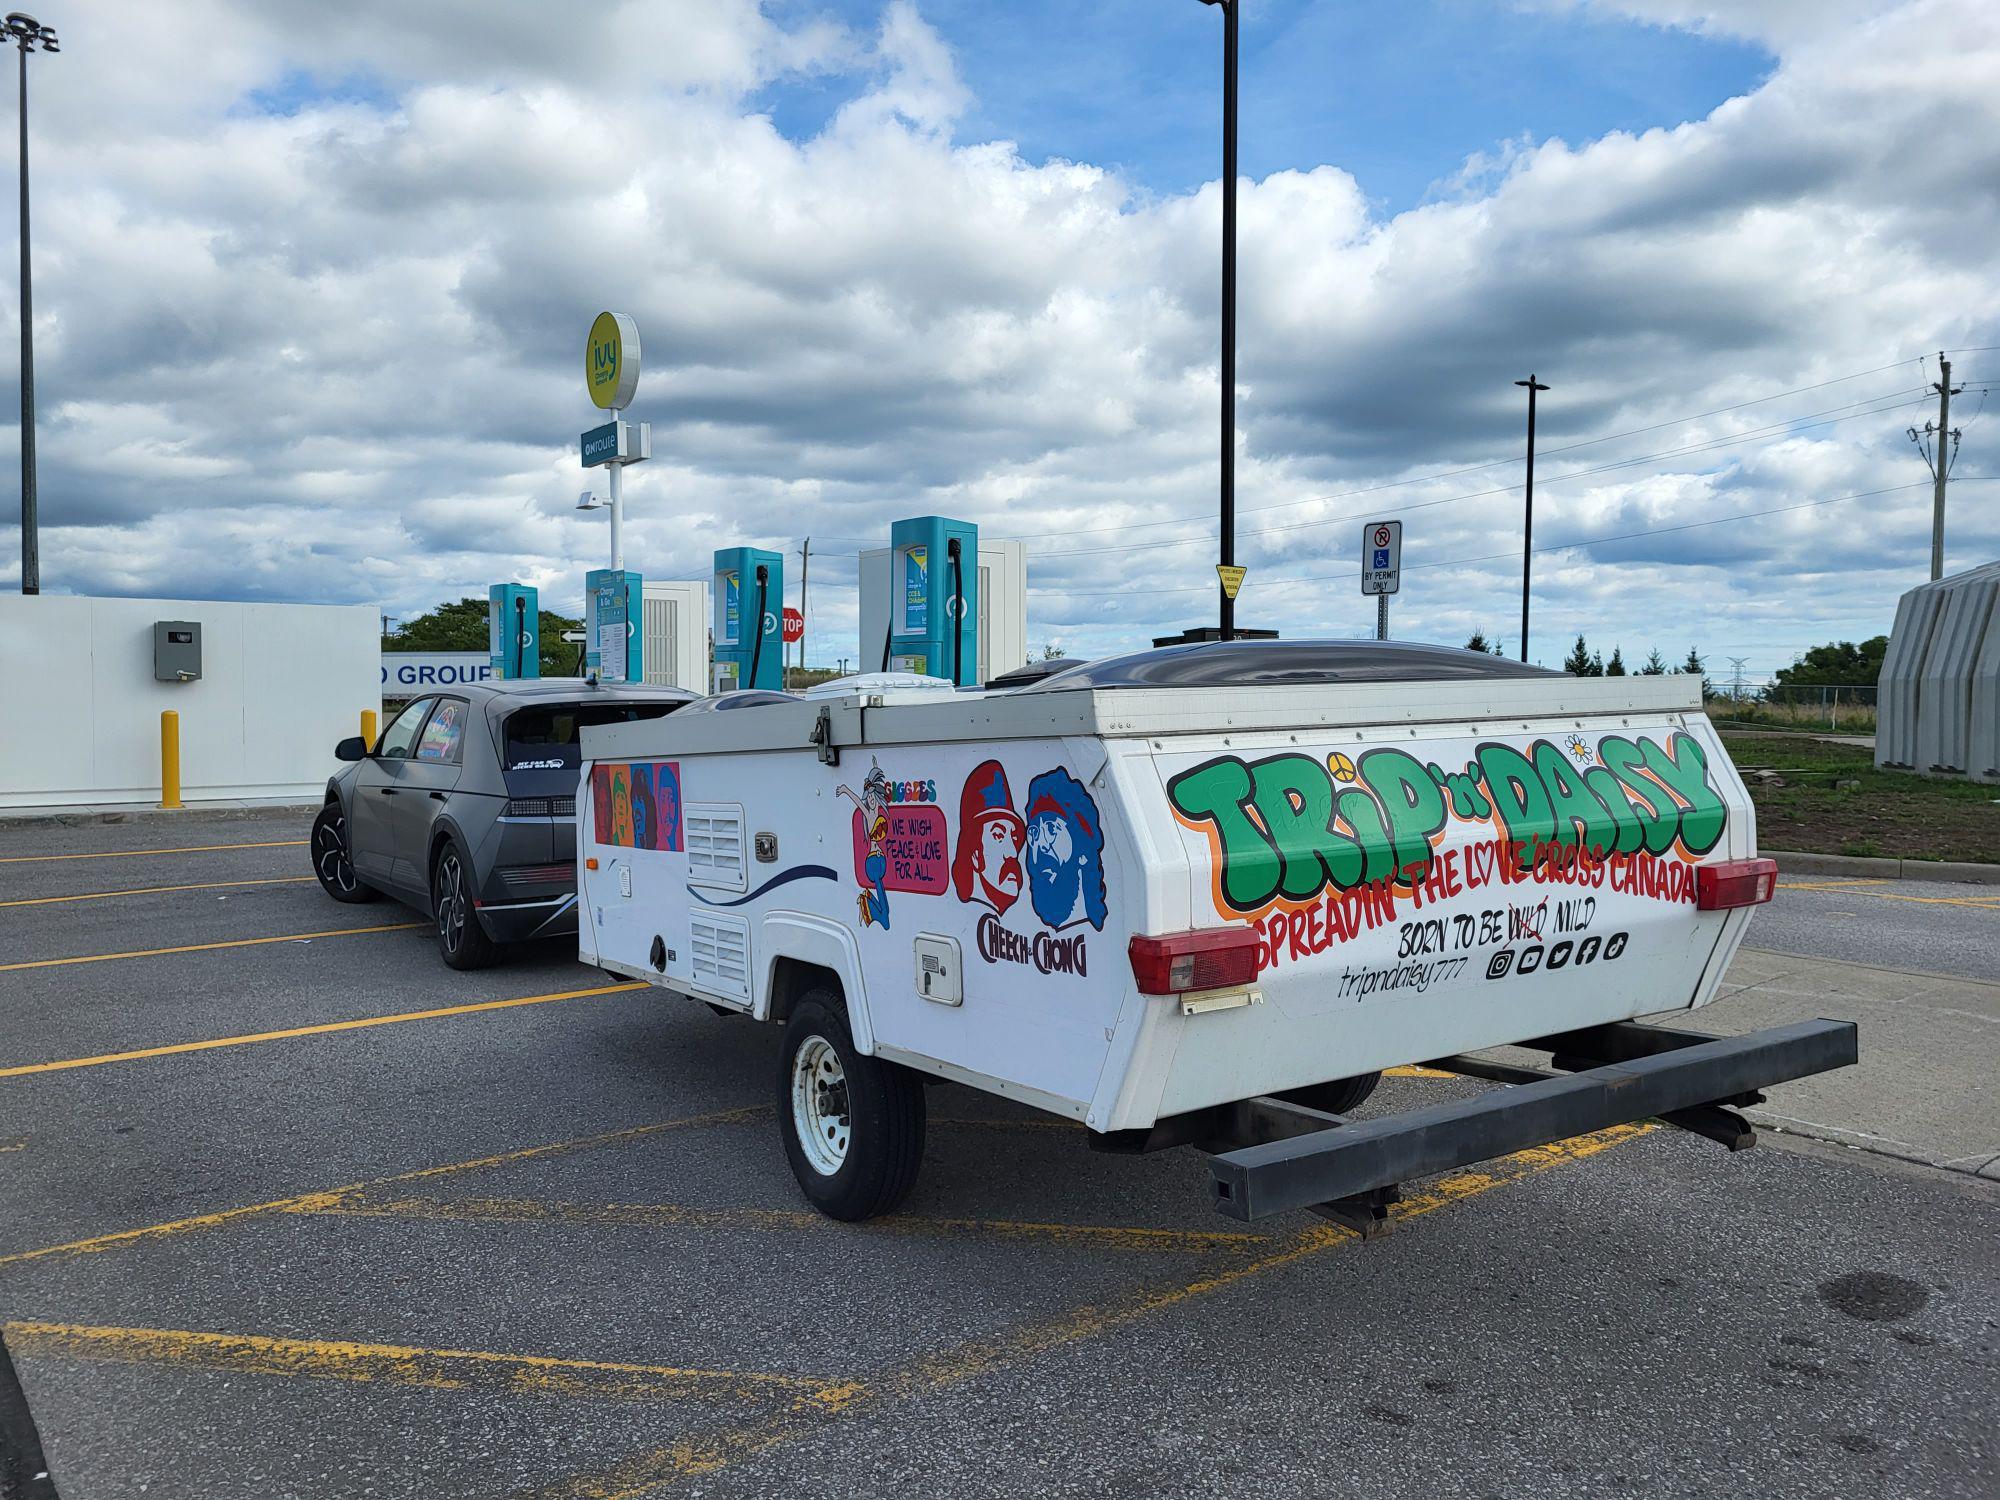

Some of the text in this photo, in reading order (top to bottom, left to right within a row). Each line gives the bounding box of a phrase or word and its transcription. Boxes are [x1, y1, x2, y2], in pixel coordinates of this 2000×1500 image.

[595, 339, 616, 380] ivy
[1365, 570, 1396, 580] BY PERMIT
[1373, 580, 1388, 590] ONLY
[783, 619, 803, 632] TOP
[398, 665, 490, 684] GROUP
[884, 779, 937, 803] GIGGLES
[892, 818, 932, 836] WE WISH
[885, 839, 915, 860] PEACE
[920, 841, 941, 860] LOVE
[894, 861, 912, 880] FOR
[1403, 849, 1463, 909] THE
[1610, 849, 1697, 904] CANADA
[1398, 917, 1449, 958] BORN
[1454, 914, 1475, 949] TO
[1478, 910, 1504, 945] BE
[1553, 896, 1596, 933] MILD
[1338, 957, 1468, 1002] tripndaisy777
